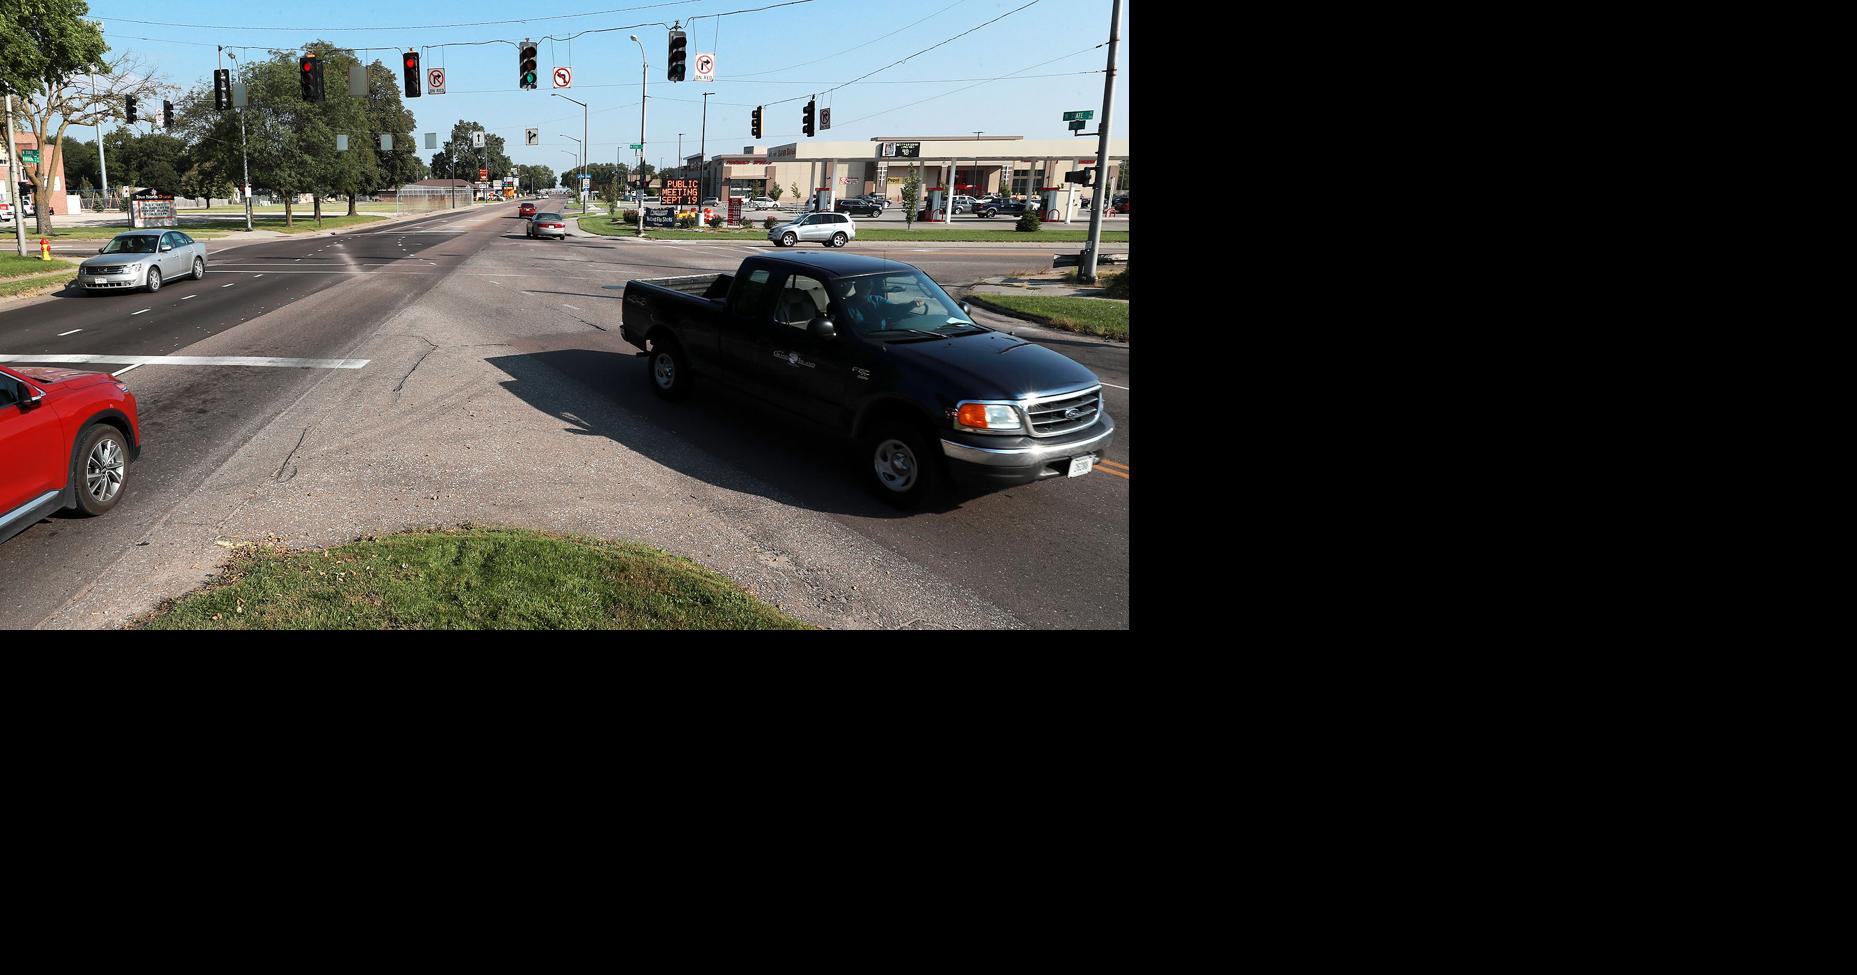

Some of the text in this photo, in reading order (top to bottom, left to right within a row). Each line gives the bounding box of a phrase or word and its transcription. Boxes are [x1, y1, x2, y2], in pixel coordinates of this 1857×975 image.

[667, 180, 698, 188] PUBLIC
[661, 188, 698, 196] MEETING
[661, 196, 698, 204] SEPT 19
